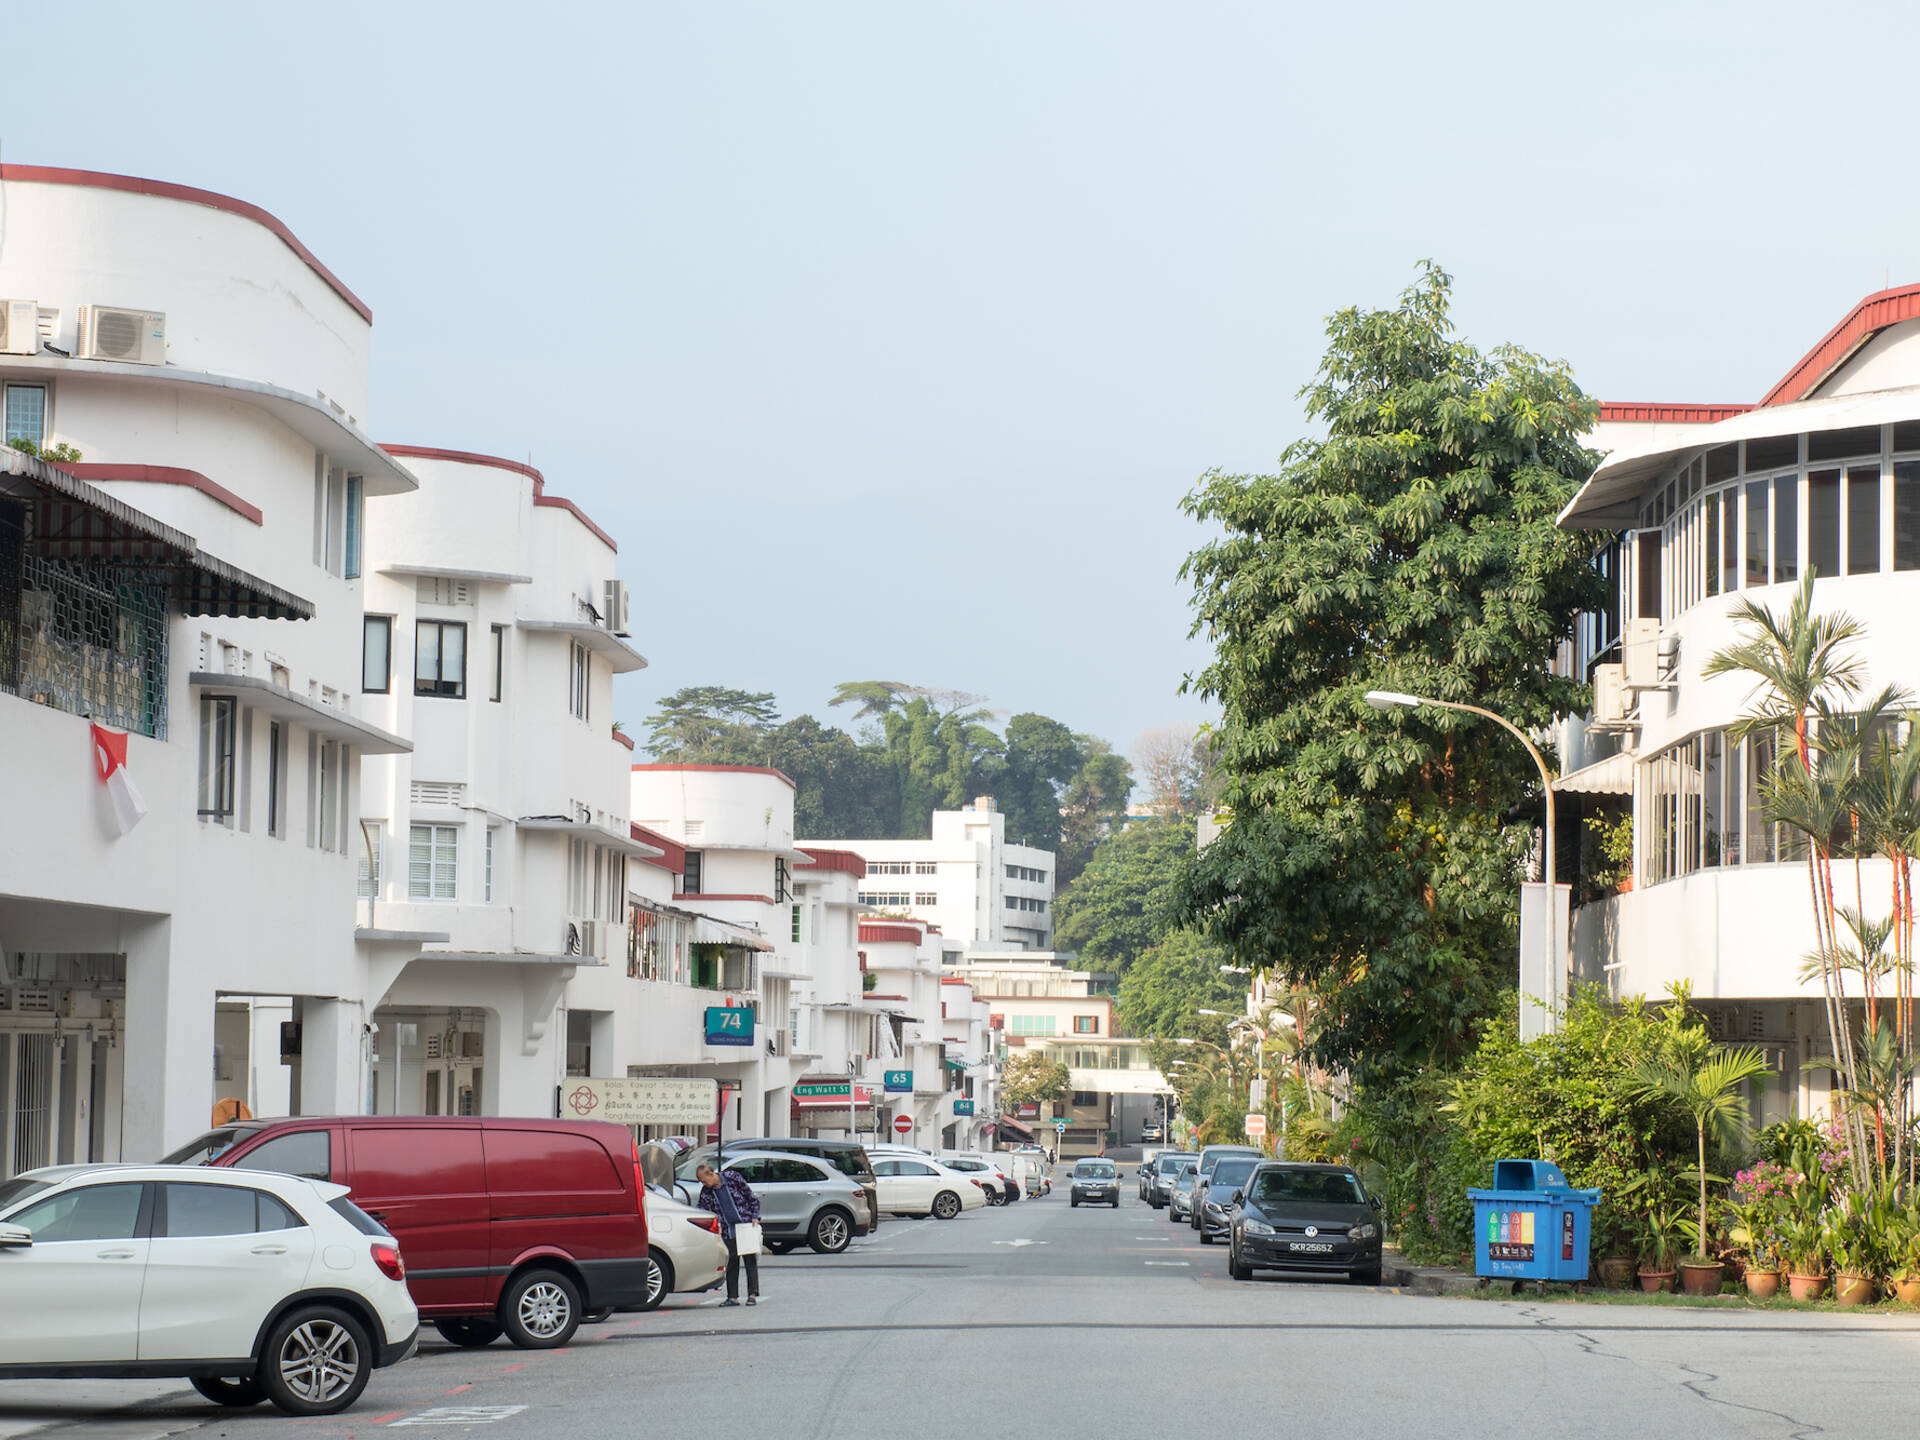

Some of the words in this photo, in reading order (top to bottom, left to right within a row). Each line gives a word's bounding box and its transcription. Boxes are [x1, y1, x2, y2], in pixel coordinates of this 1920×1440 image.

[720, 1013, 741, 1029] 74
[892, 1073, 907, 1083] 65
[797, 1086, 812, 1095] Eng
[815, 1086, 837, 1094] Watt
[838, 1085, 849, 1093] St
